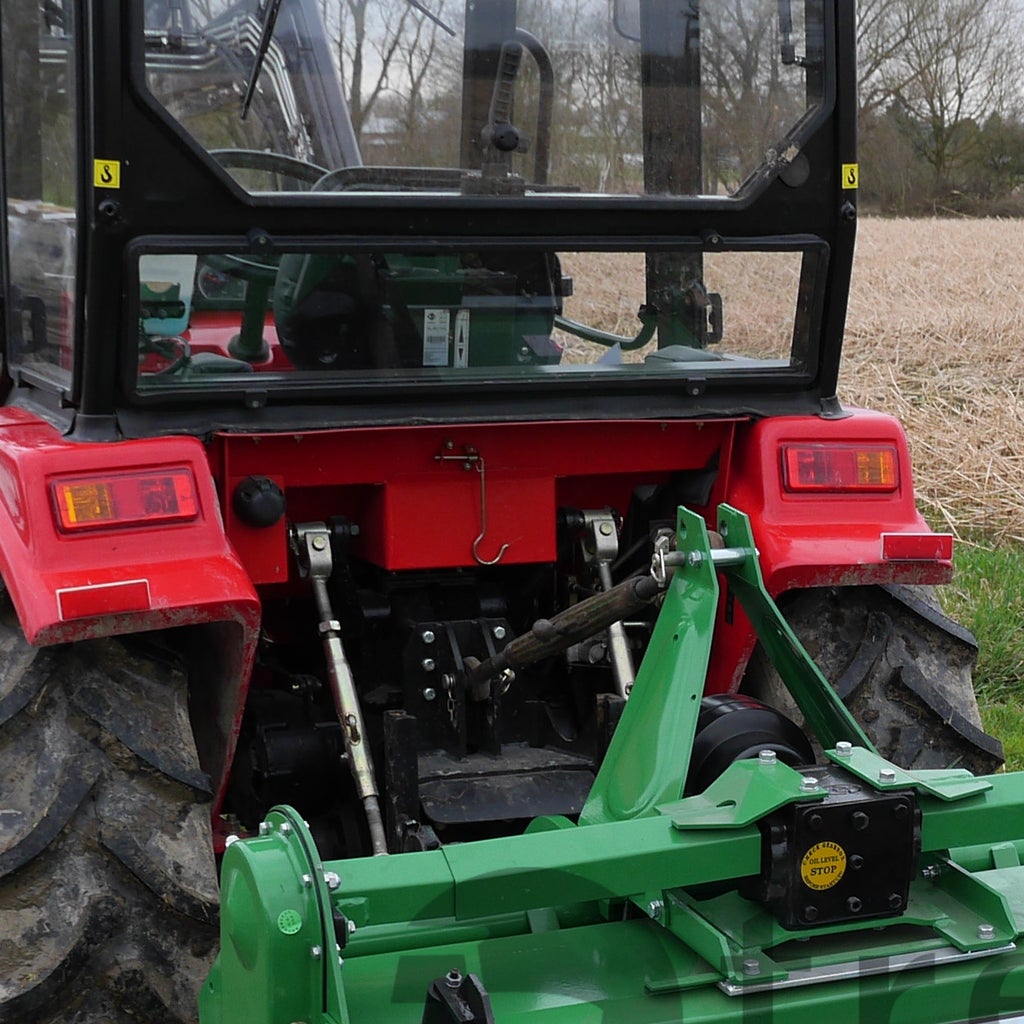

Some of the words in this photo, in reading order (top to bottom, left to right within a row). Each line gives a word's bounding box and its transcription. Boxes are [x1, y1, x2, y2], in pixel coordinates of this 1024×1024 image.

[809, 857, 819, 865] OIL
[821, 855, 839, 863] LEVEL
[811, 865, 837, 876] STOP
